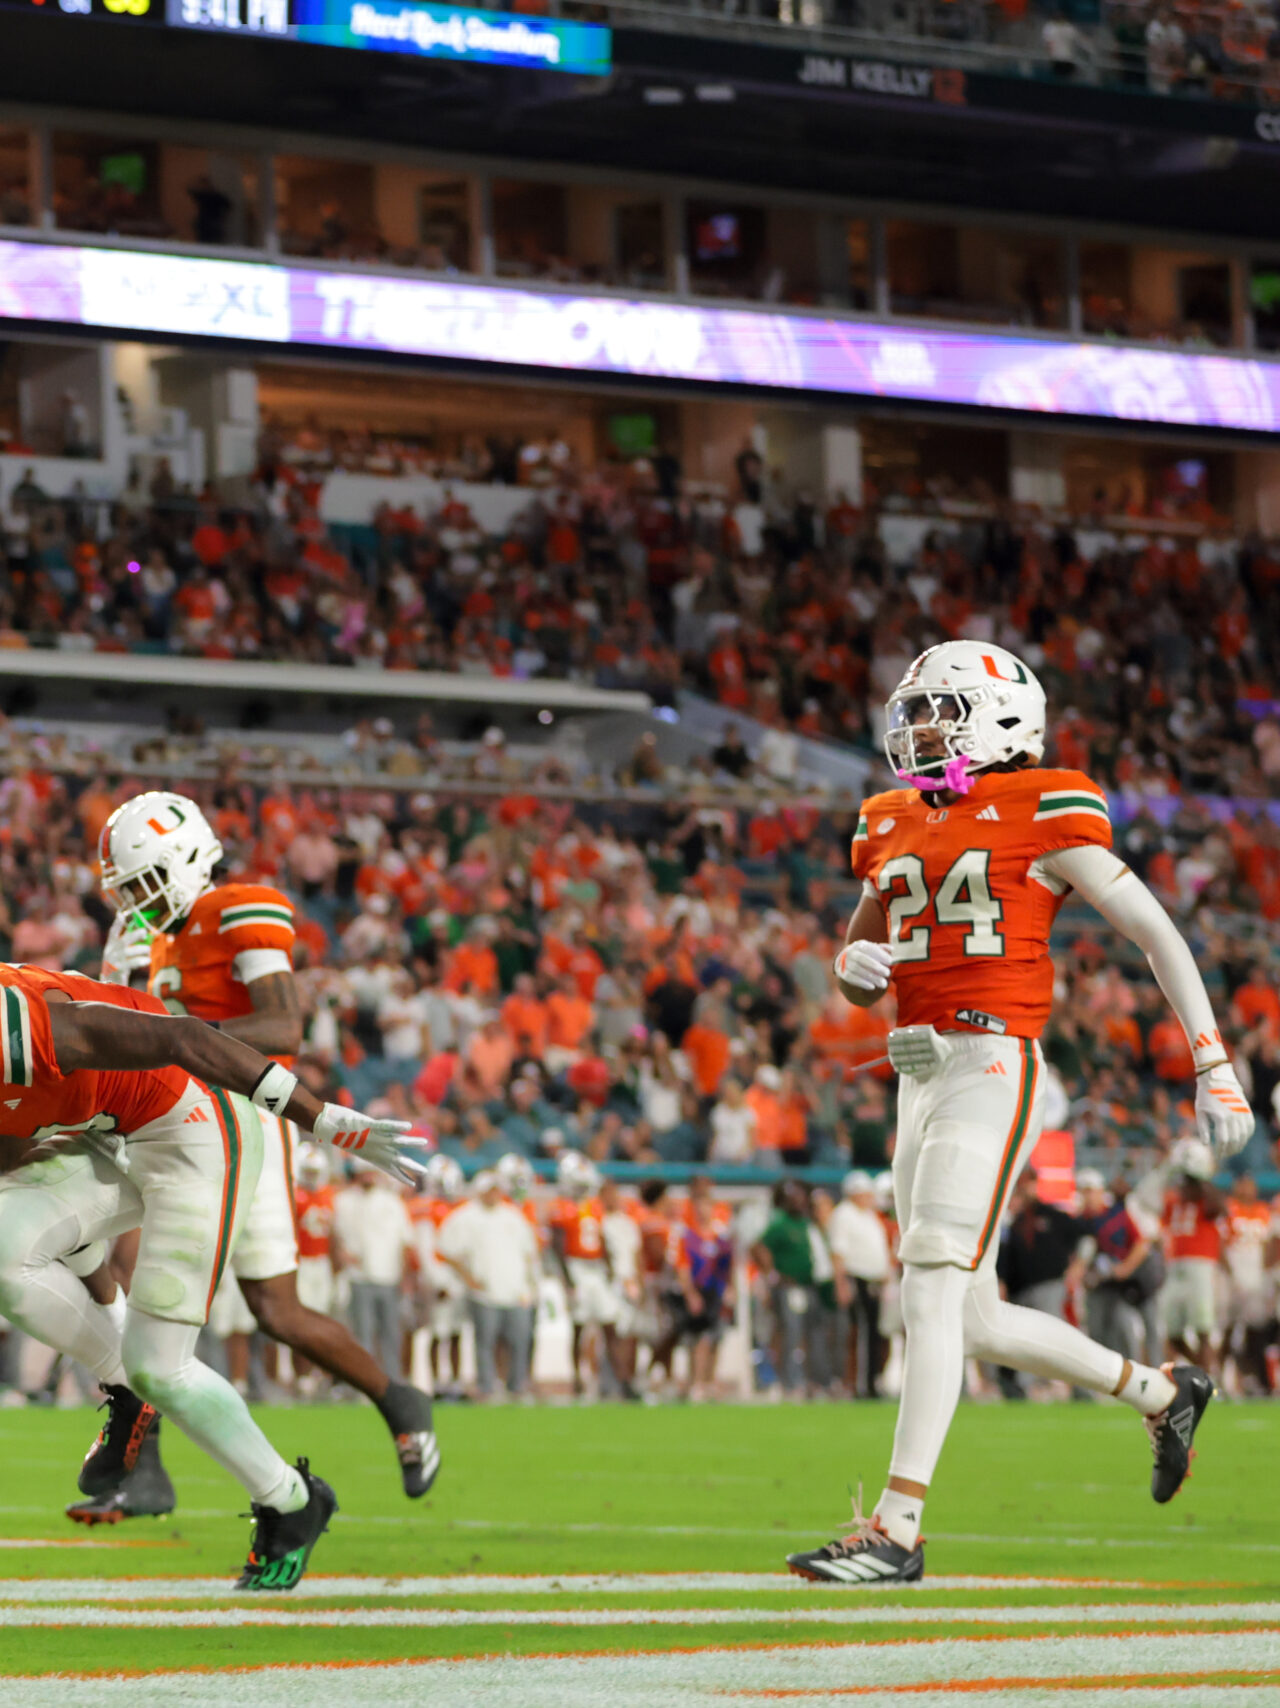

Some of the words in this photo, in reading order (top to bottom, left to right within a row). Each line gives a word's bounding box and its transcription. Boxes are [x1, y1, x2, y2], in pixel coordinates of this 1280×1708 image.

[351, 2, 411, 40] Hard
[412, 10, 466, 52] Rock
[466, 16, 561, 64] Stadium
[798, 56, 847, 86] JIM
[851, 60, 934, 97] KELLY
[980, 655, 1028, 685] U
[147, 805, 186, 836] U
[878, 848, 1005, 966] 24
